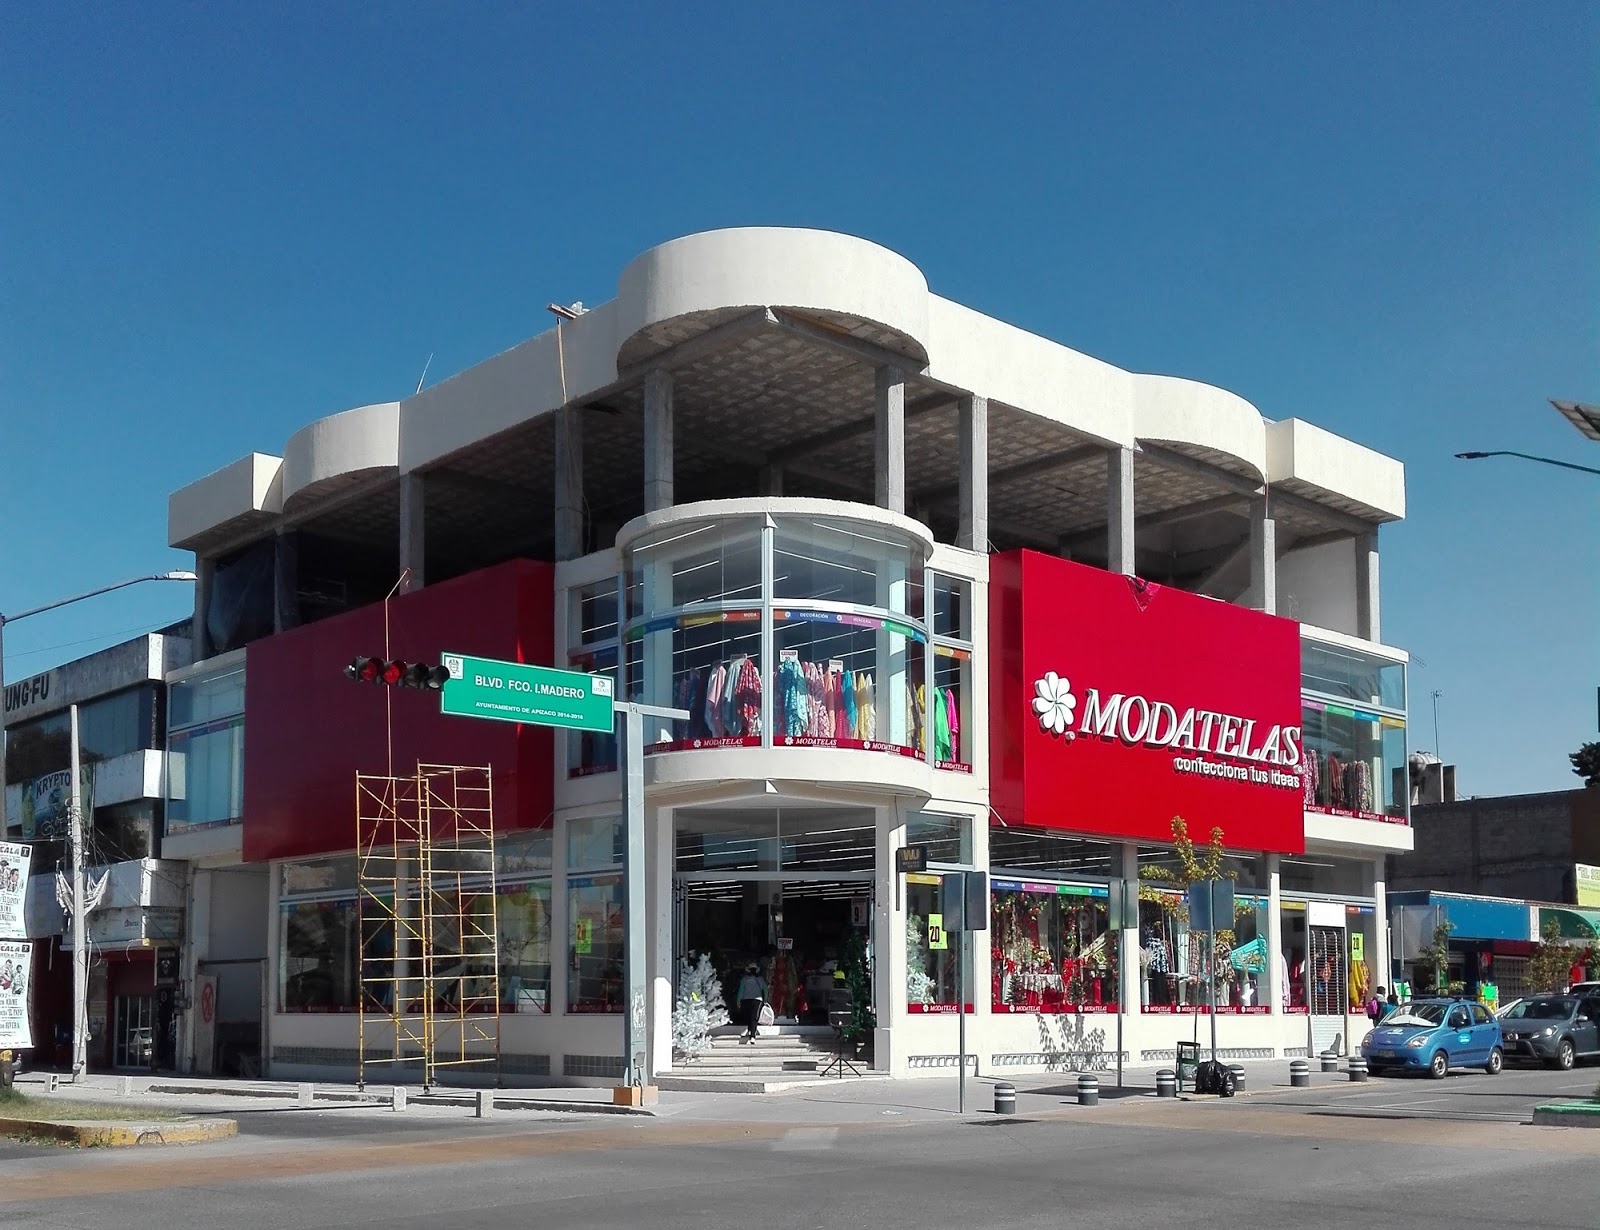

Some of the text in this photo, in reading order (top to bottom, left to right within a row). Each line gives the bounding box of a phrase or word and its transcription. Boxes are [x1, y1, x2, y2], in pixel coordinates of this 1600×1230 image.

[475, 674, 585, 699] BLVD. FCO. I.MADERO
[475, 701, 521, 712] AYUNTAMIENTO
[531, 708, 557, 717] APIZACO
[1079, 688, 1301, 766] MODATELAS
[703, 738, 743, 747] MODATELAS
[795, 737, 838, 746] MODATELAS
[872, 742, 901, 752] MODATELAS
[941, 762, 969, 771] MODATELAS
[1174, 757, 1300, 788] confecciona tus ideas
[36, 772, 71, 800] KRYPTO
